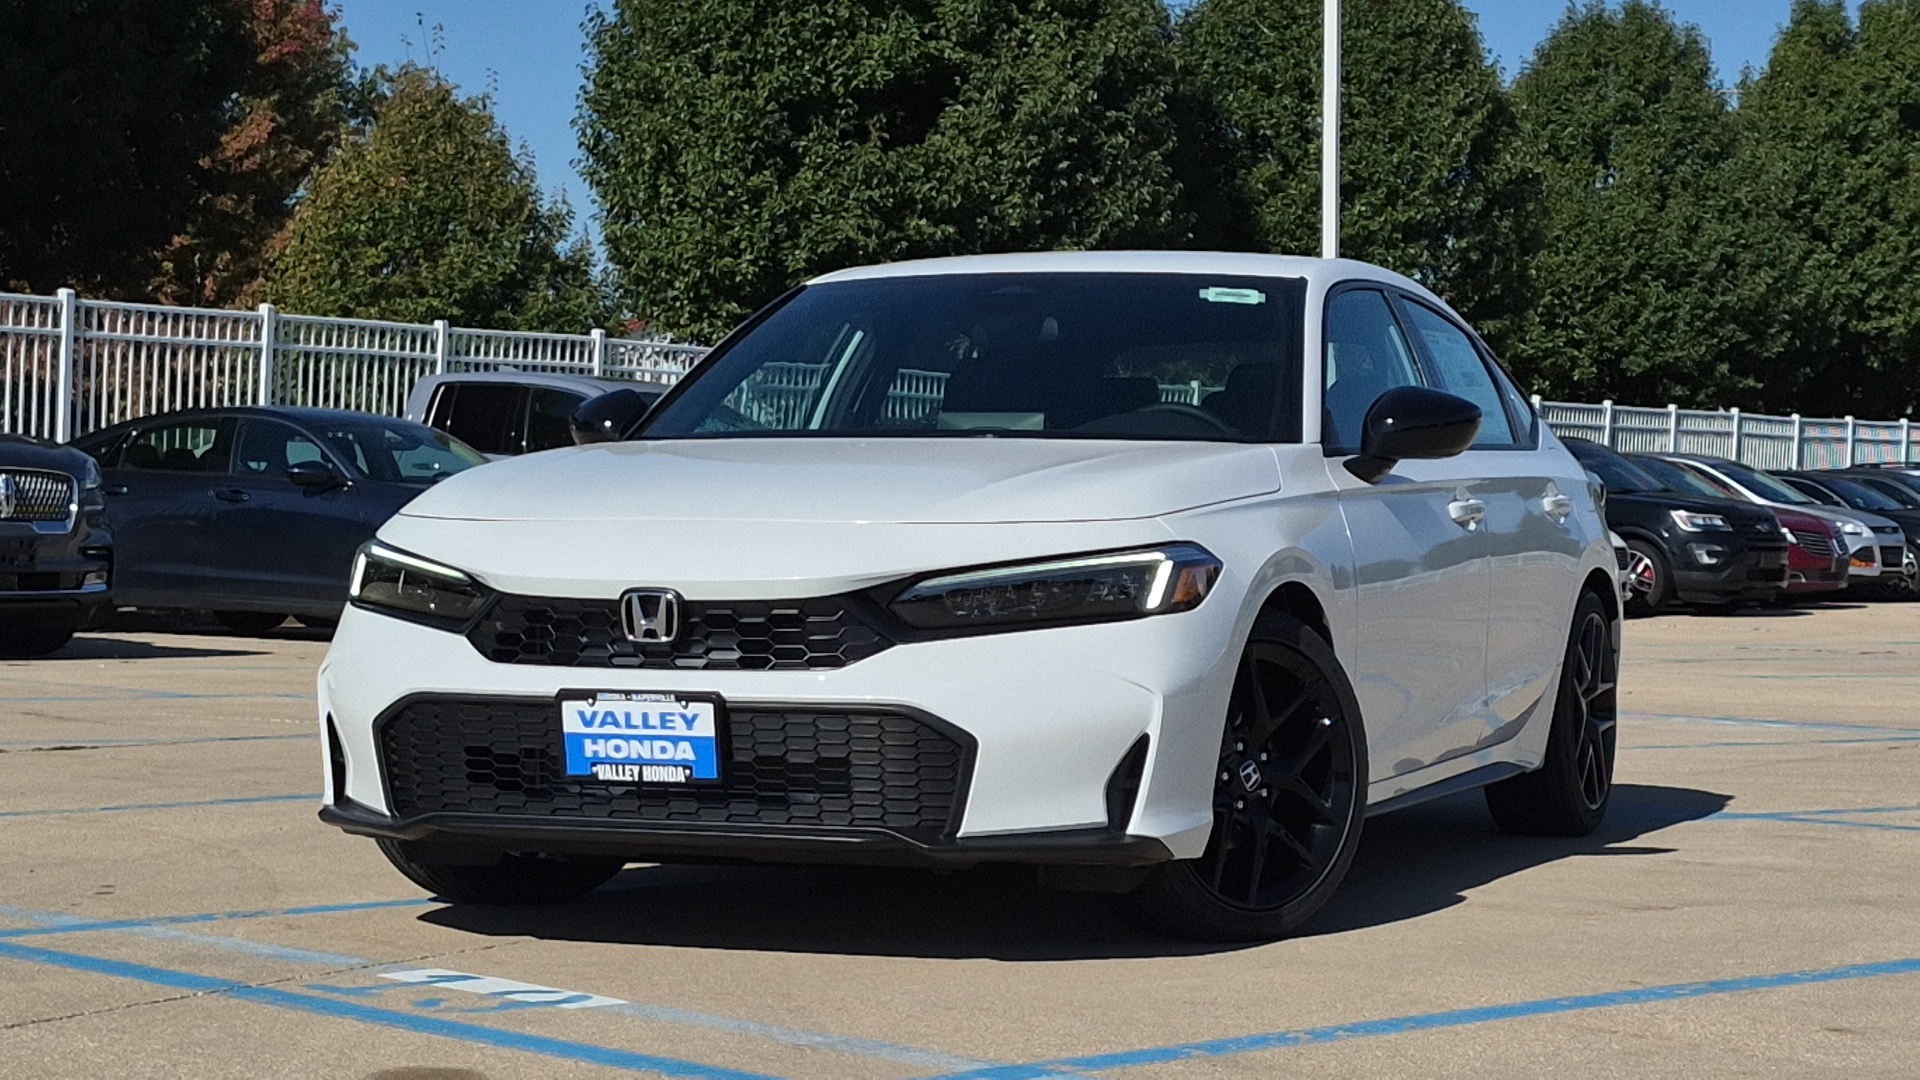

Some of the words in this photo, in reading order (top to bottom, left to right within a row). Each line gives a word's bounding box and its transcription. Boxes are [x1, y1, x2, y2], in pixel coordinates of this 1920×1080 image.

[577, 710, 700, 731] VALLEY
[584, 738, 697, 760] HONDA
[597, 764, 640, 781] VALLEY
[642, 765, 686, 783] HONDA
